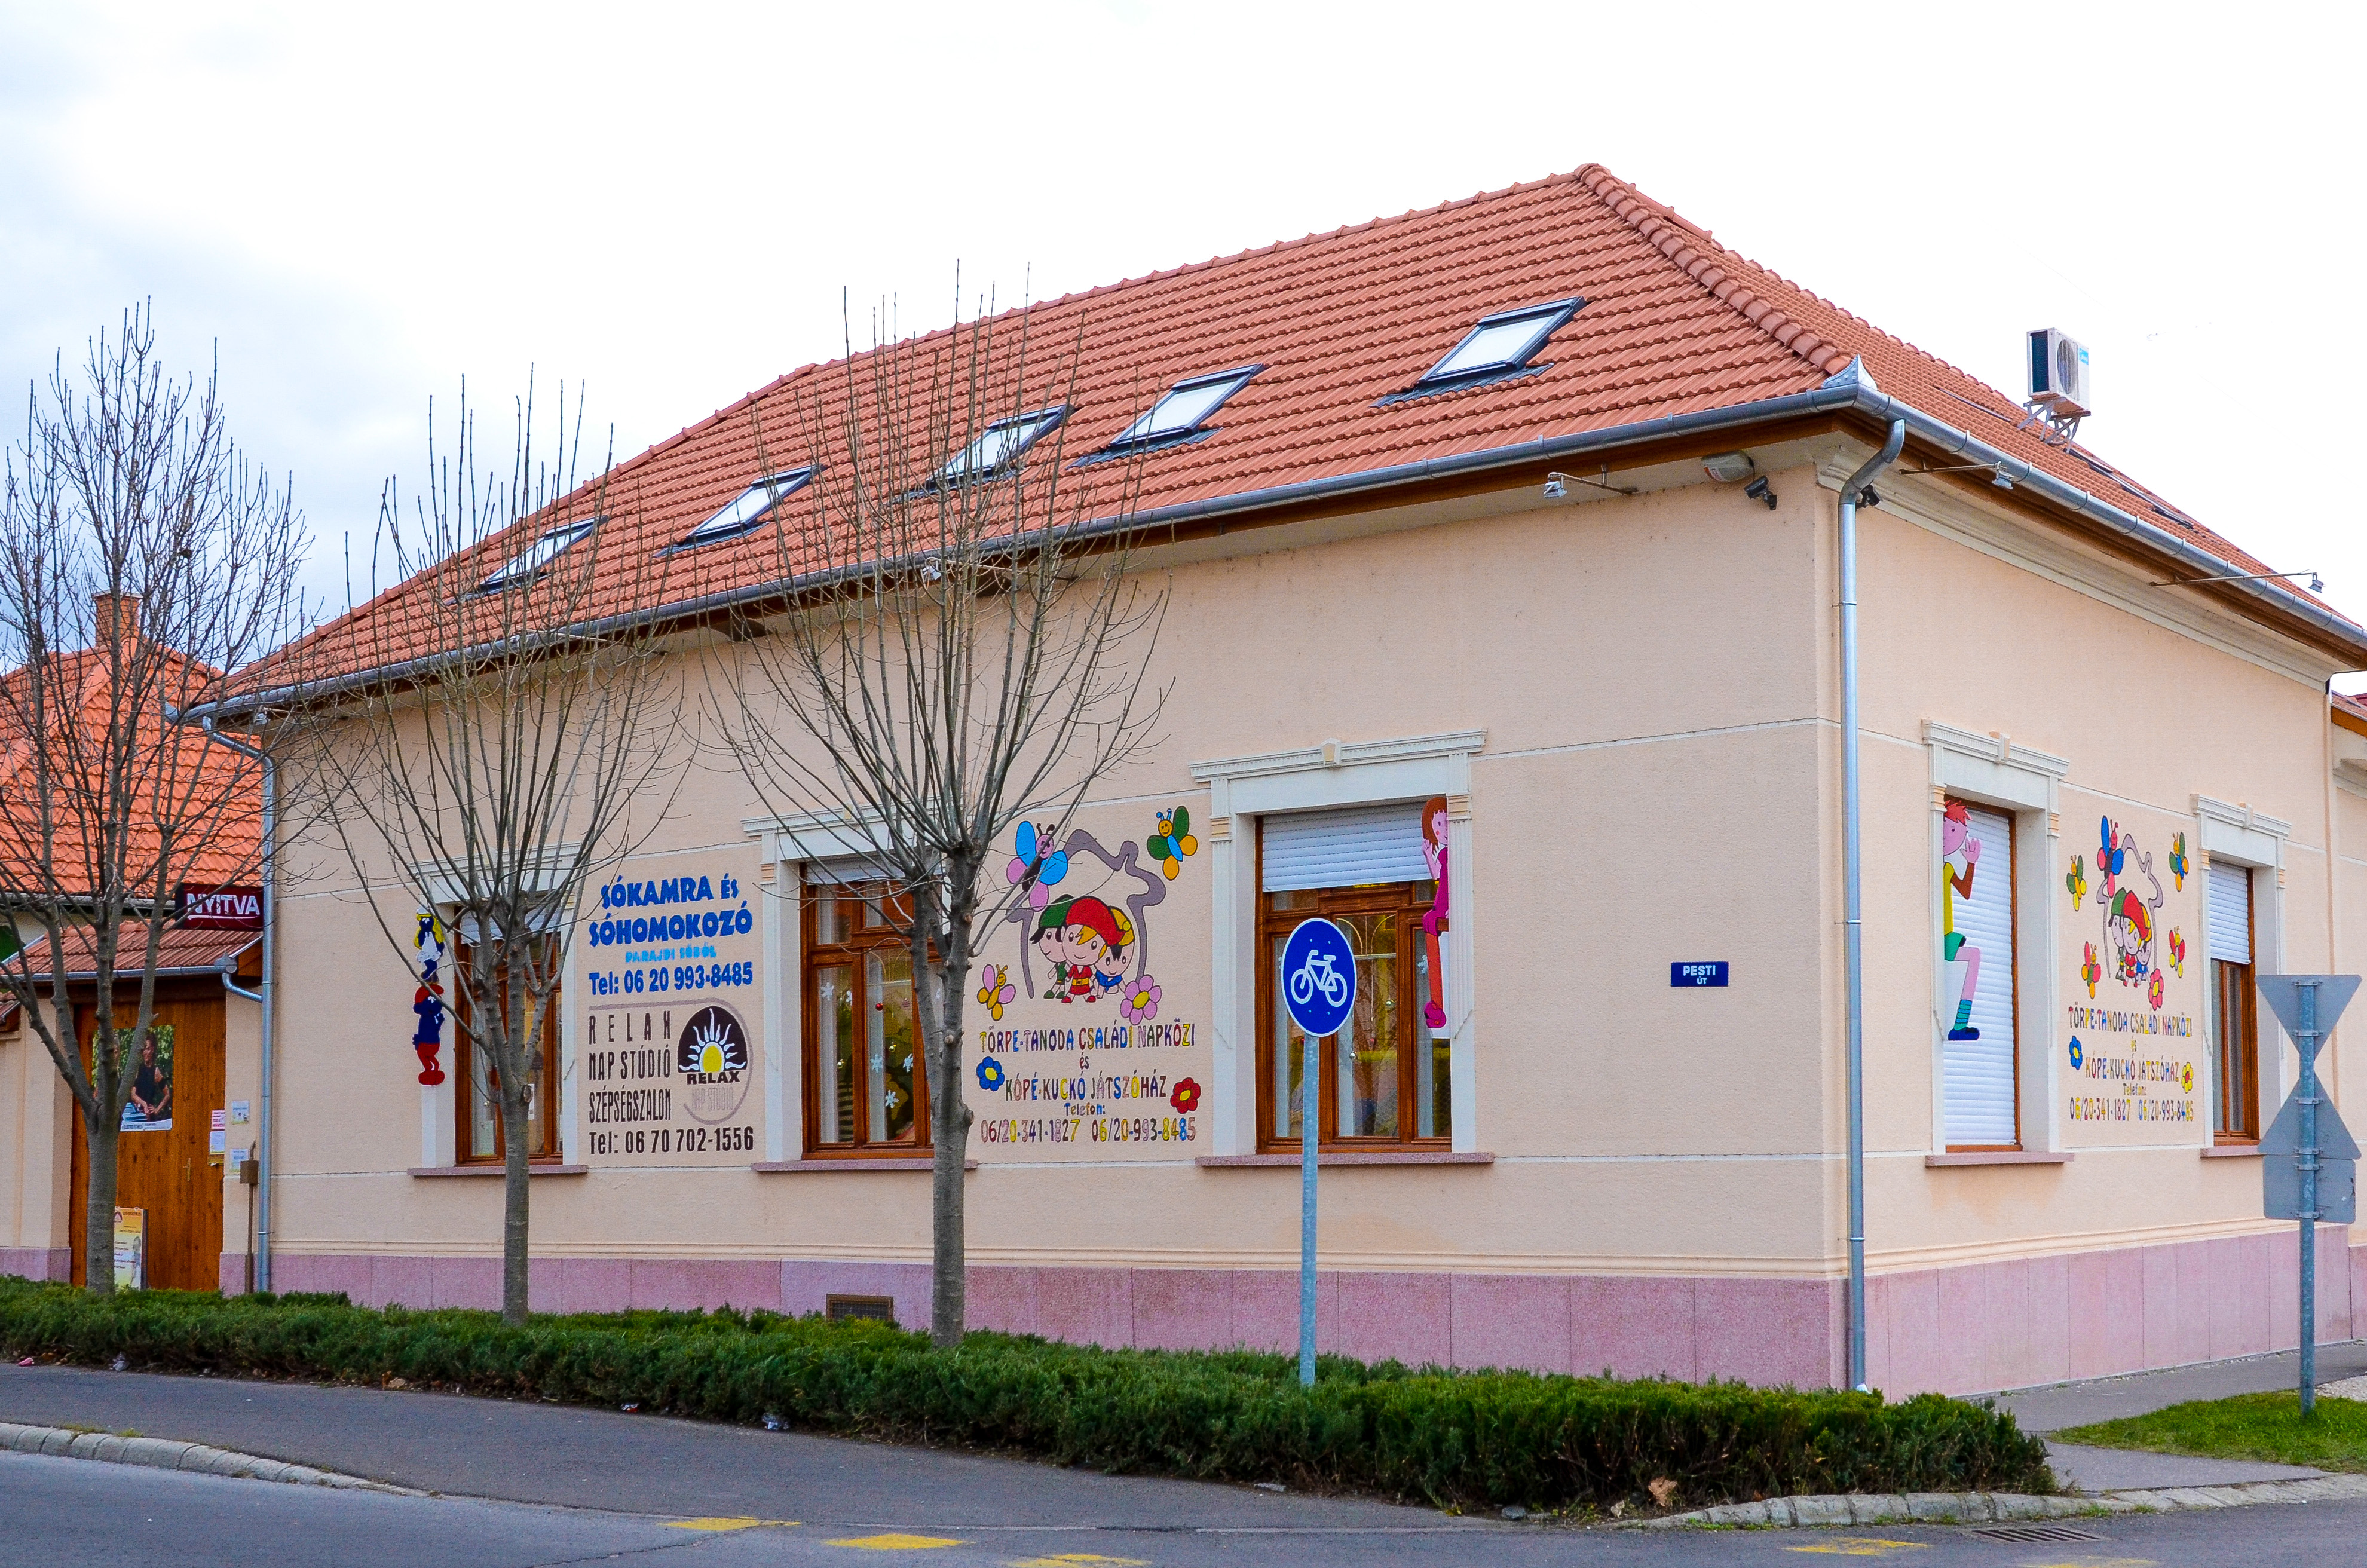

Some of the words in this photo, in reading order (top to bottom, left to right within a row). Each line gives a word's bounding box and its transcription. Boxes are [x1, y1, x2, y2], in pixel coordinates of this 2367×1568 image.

[187, 893, 260, 915] NYITVA
[601, 875, 714, 909] SÓKAMRA
[721, 873, 739, 899] ÉS
[589, 900, 752, 947] SÓHOMOKOZÓ
[589, 971, 618, 995] Tel:
[624, 969, 644, 994] 06
[649, 966, 669, 992] 20
[674, 961, 752, 990] 993-8485
[1683, 964, 1716, 976] PESTI
[1697, 975, 1707, 985] ÚT
[1079, 1019, 1133, 1050] CSALÁDI
[1137, 1018, 1196, 1048] NAPKÖZI
[589, 1051, 614, 1080] NAP
[620, 1044, 670, 1080] STÚDIÓ
[1079, 1052, 1089, 1070] és
[687, 1071, 740, 1085] RELAX
[1005, 1070, 1086, 1101] KÓPÉ-KUCKÓ
[1091, 1069, 1167, 1100] JÁTSZÓHÁZ
[589, 1084, 671, 1123] SZÉPSÉGSZALON
[1064, 1102, 1106, 1116] Telefon:
[589, 1131, 618, 1155] Tel:
[625, 1130, 645, 1154] 06
[650, 1129, 670, 1153] 70
[676, 1126, 754, 1152] 702-1556
[980, 1119, 1080, 1143] 06/20-341-1827
[1092, 1117, 1196, 1142] 06/20-993-8485
